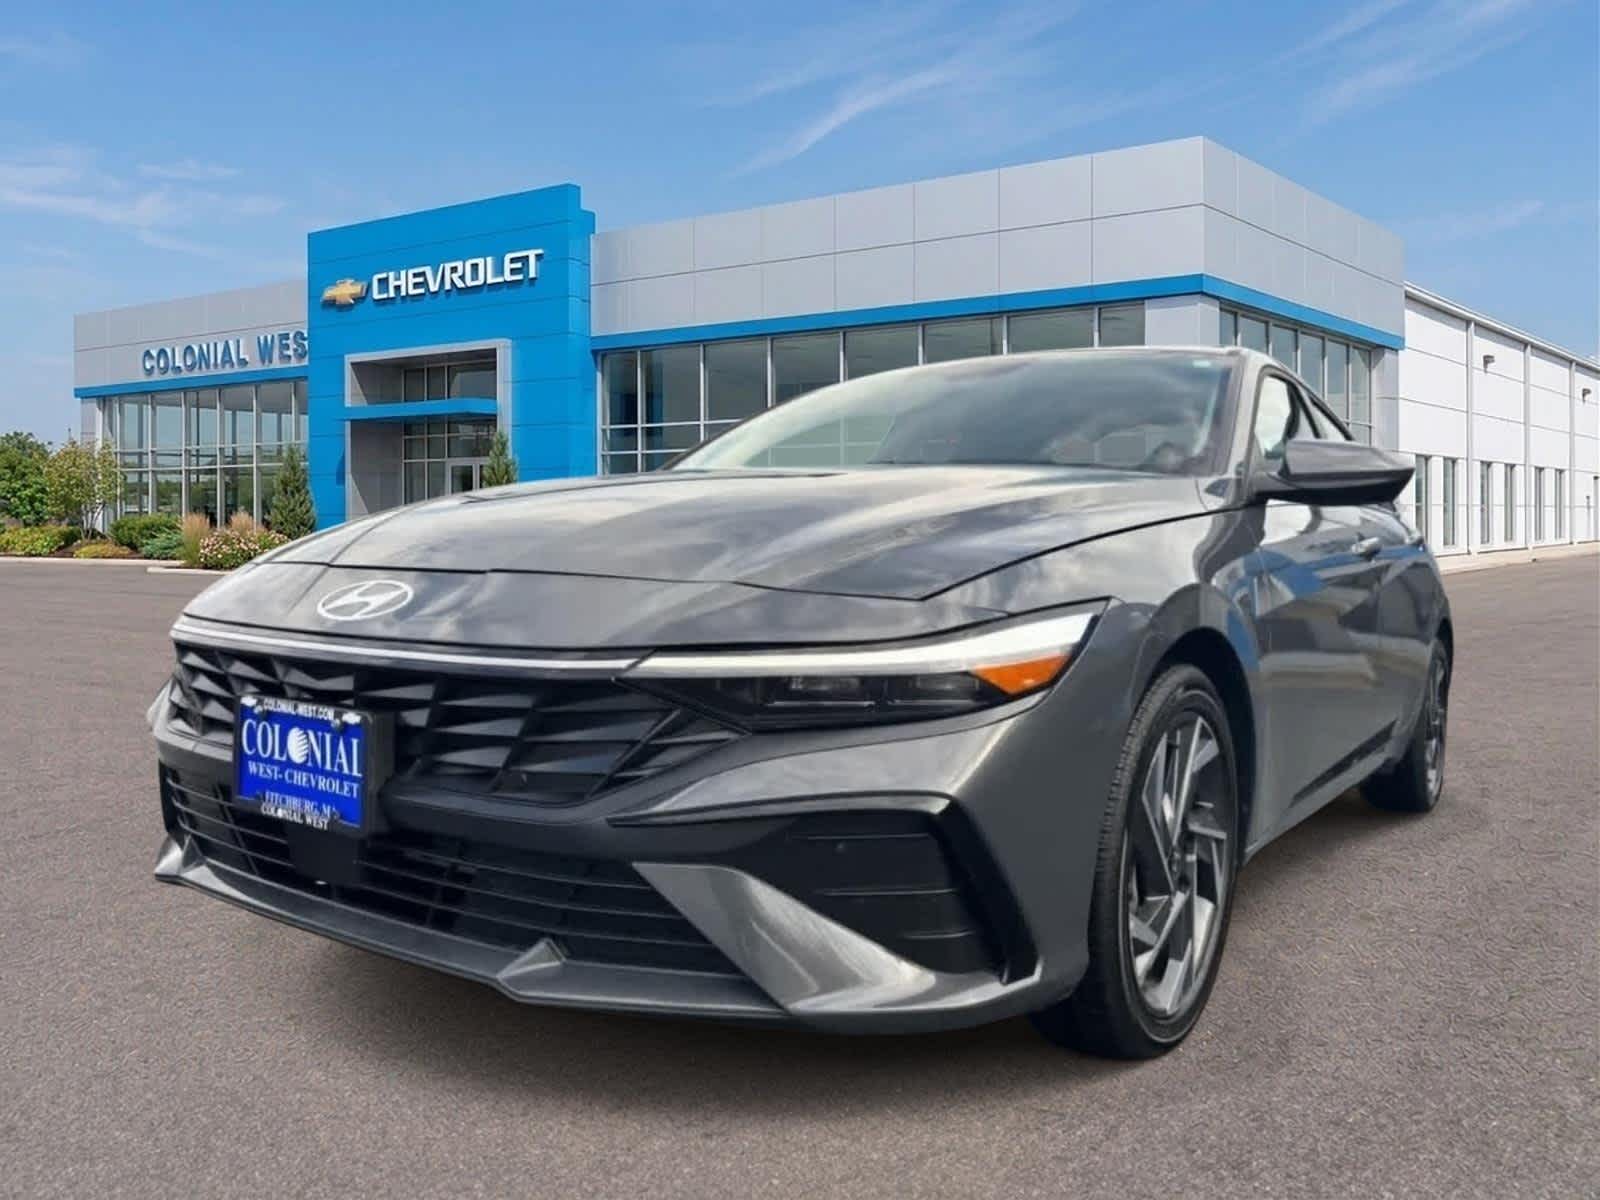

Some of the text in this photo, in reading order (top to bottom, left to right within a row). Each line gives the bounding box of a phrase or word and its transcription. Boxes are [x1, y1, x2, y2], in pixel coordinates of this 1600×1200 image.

[371, 249, 544, 301] CHEVROLET
[142, 339, 249, 376] COLONIAL
[242, 719, 363, 777] COLONIAL
[285, 768, 359, 799] CHEVROLET
[261, 802, 329, 831] COLONIAL WEST
